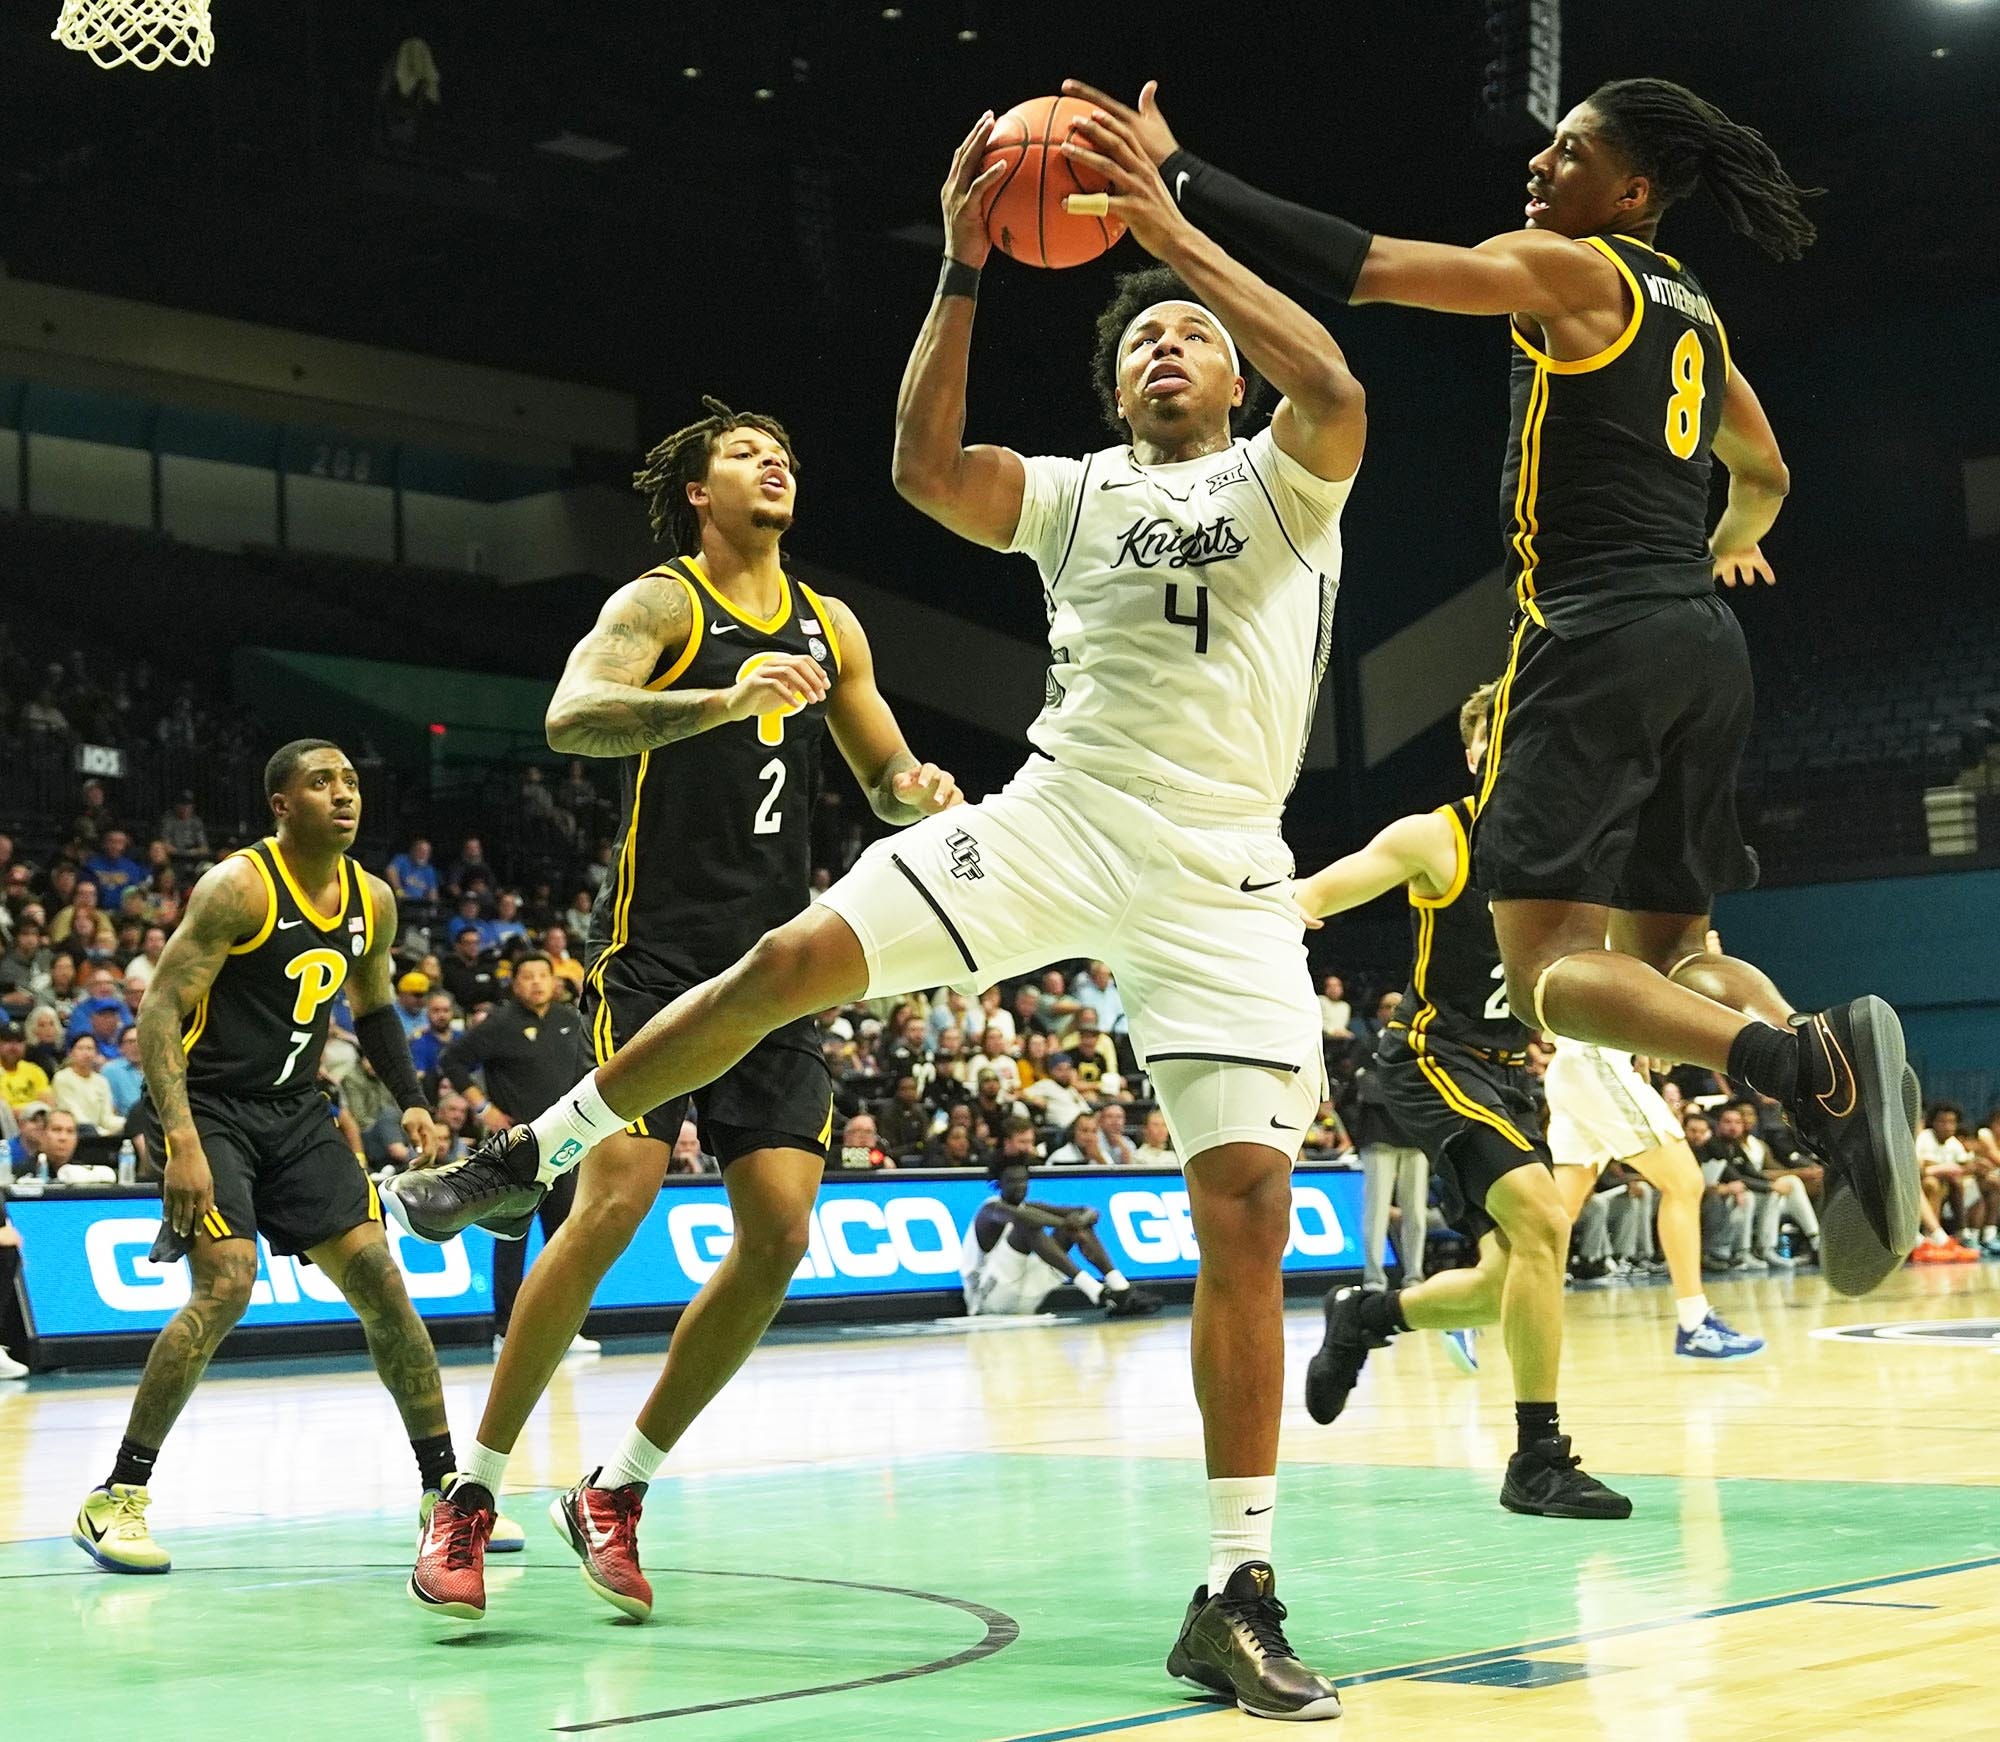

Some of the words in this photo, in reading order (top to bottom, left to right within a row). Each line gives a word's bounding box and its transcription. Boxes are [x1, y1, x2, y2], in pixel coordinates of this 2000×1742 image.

[1664, 328, 1706, 460] 8
[1110, 516, 1250, 569] Knights
[1164, 583, 1208, 654] 4
[753, 757, 787, 834] 2
[945, 826, 985, 881] UCF
[284, 947, 348, 1025] P
[272, 1030, 313, 1086] 7
[667, 1196, 963, 1285] GICO
